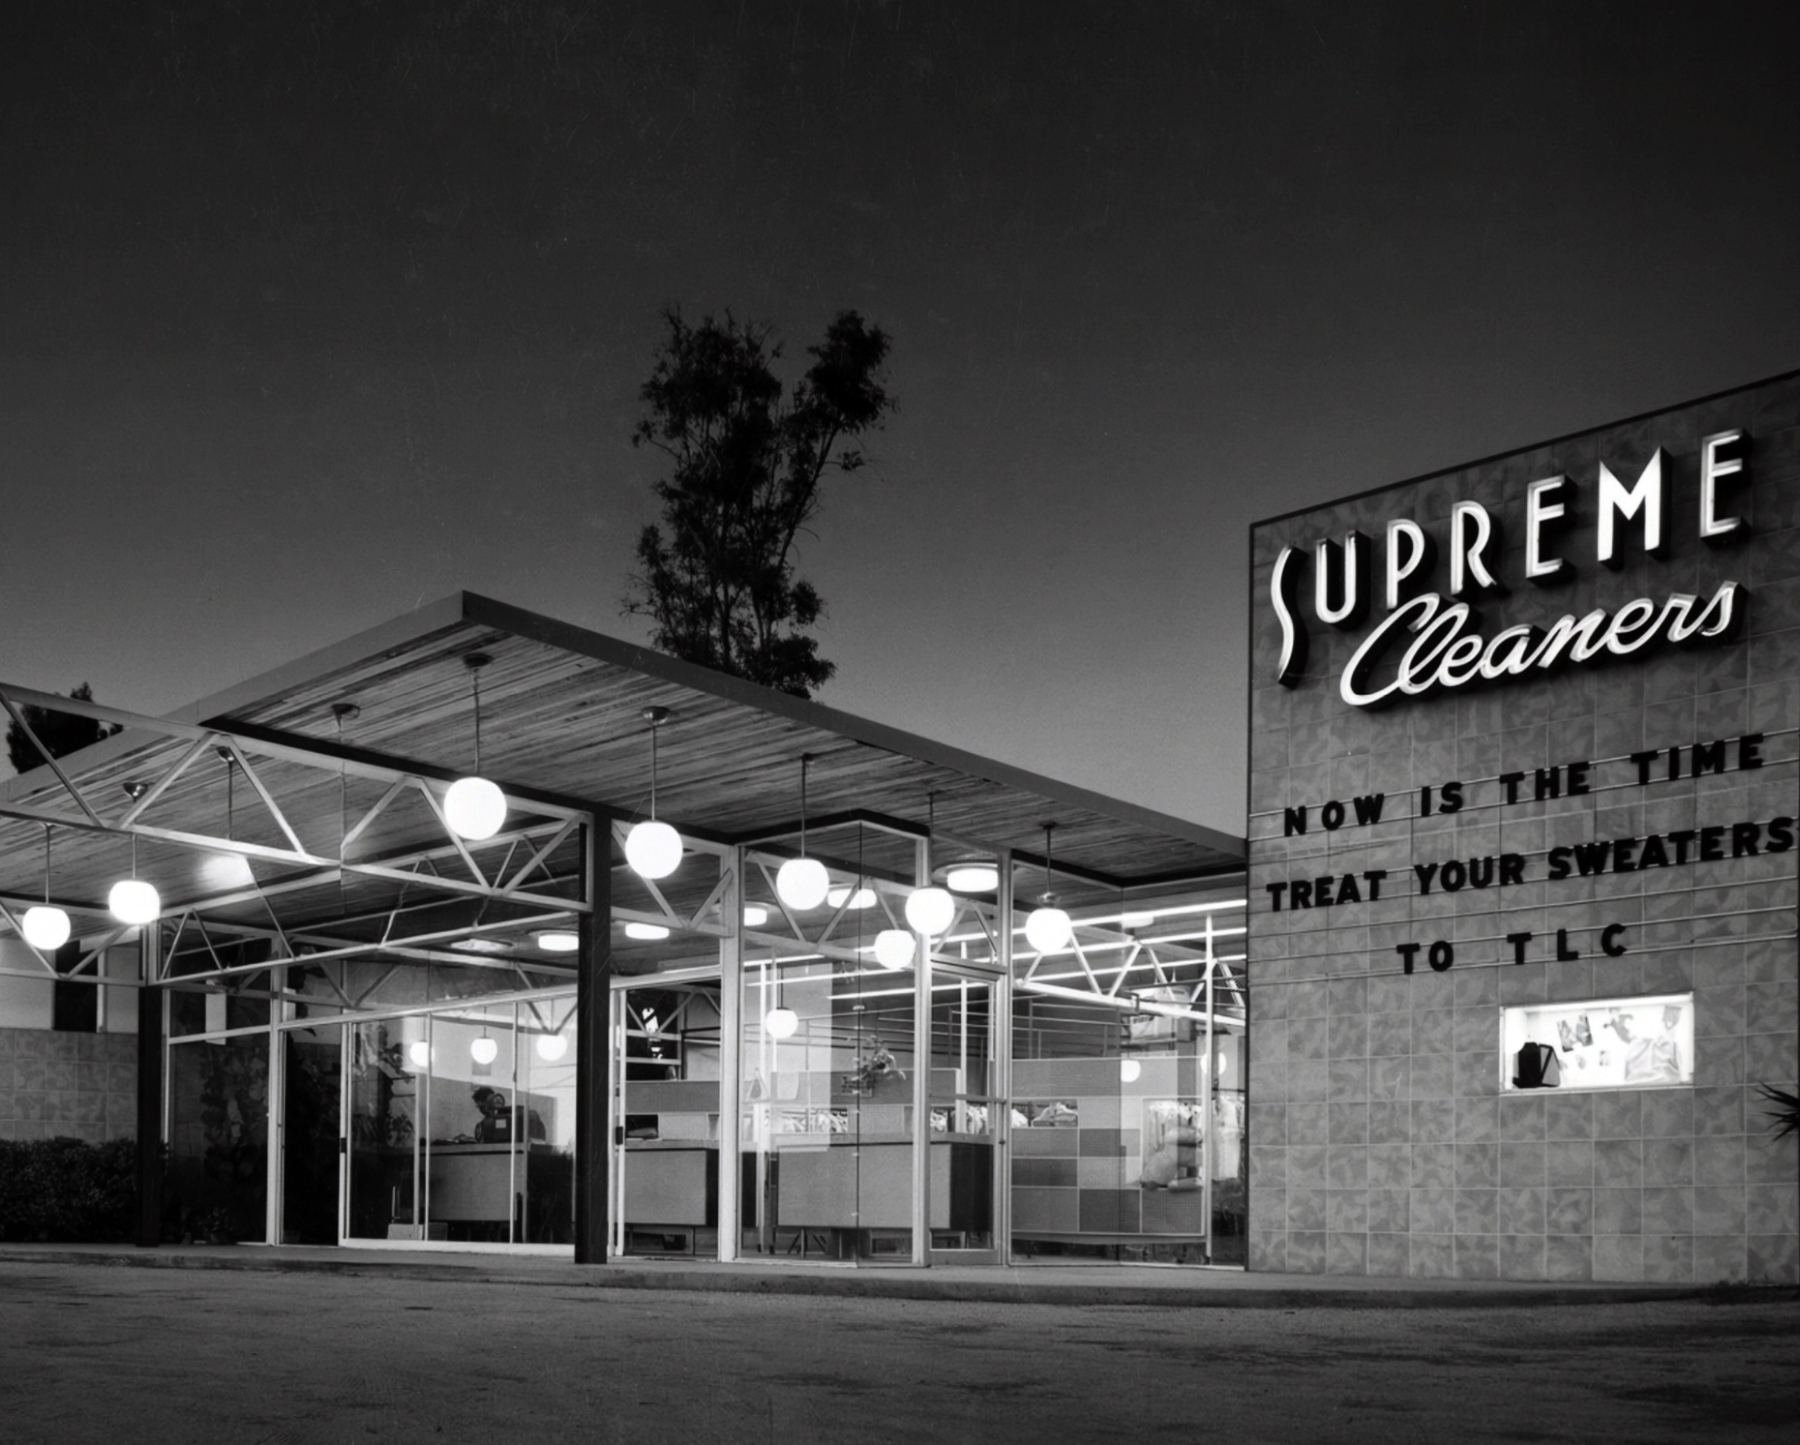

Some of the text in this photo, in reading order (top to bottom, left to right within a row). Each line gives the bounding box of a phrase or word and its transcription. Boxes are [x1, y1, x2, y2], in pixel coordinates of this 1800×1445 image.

[1271, 428, 1742, 690] SUPREME
[1340, 580, 1740, 705] Cleaners
[1284, 733, 1764, 837] NOW IS THE TIME
[1266, 816, 1795, 912] TREAT YOUR SWEATERS
[1396, 940, 1454, 975] TO
